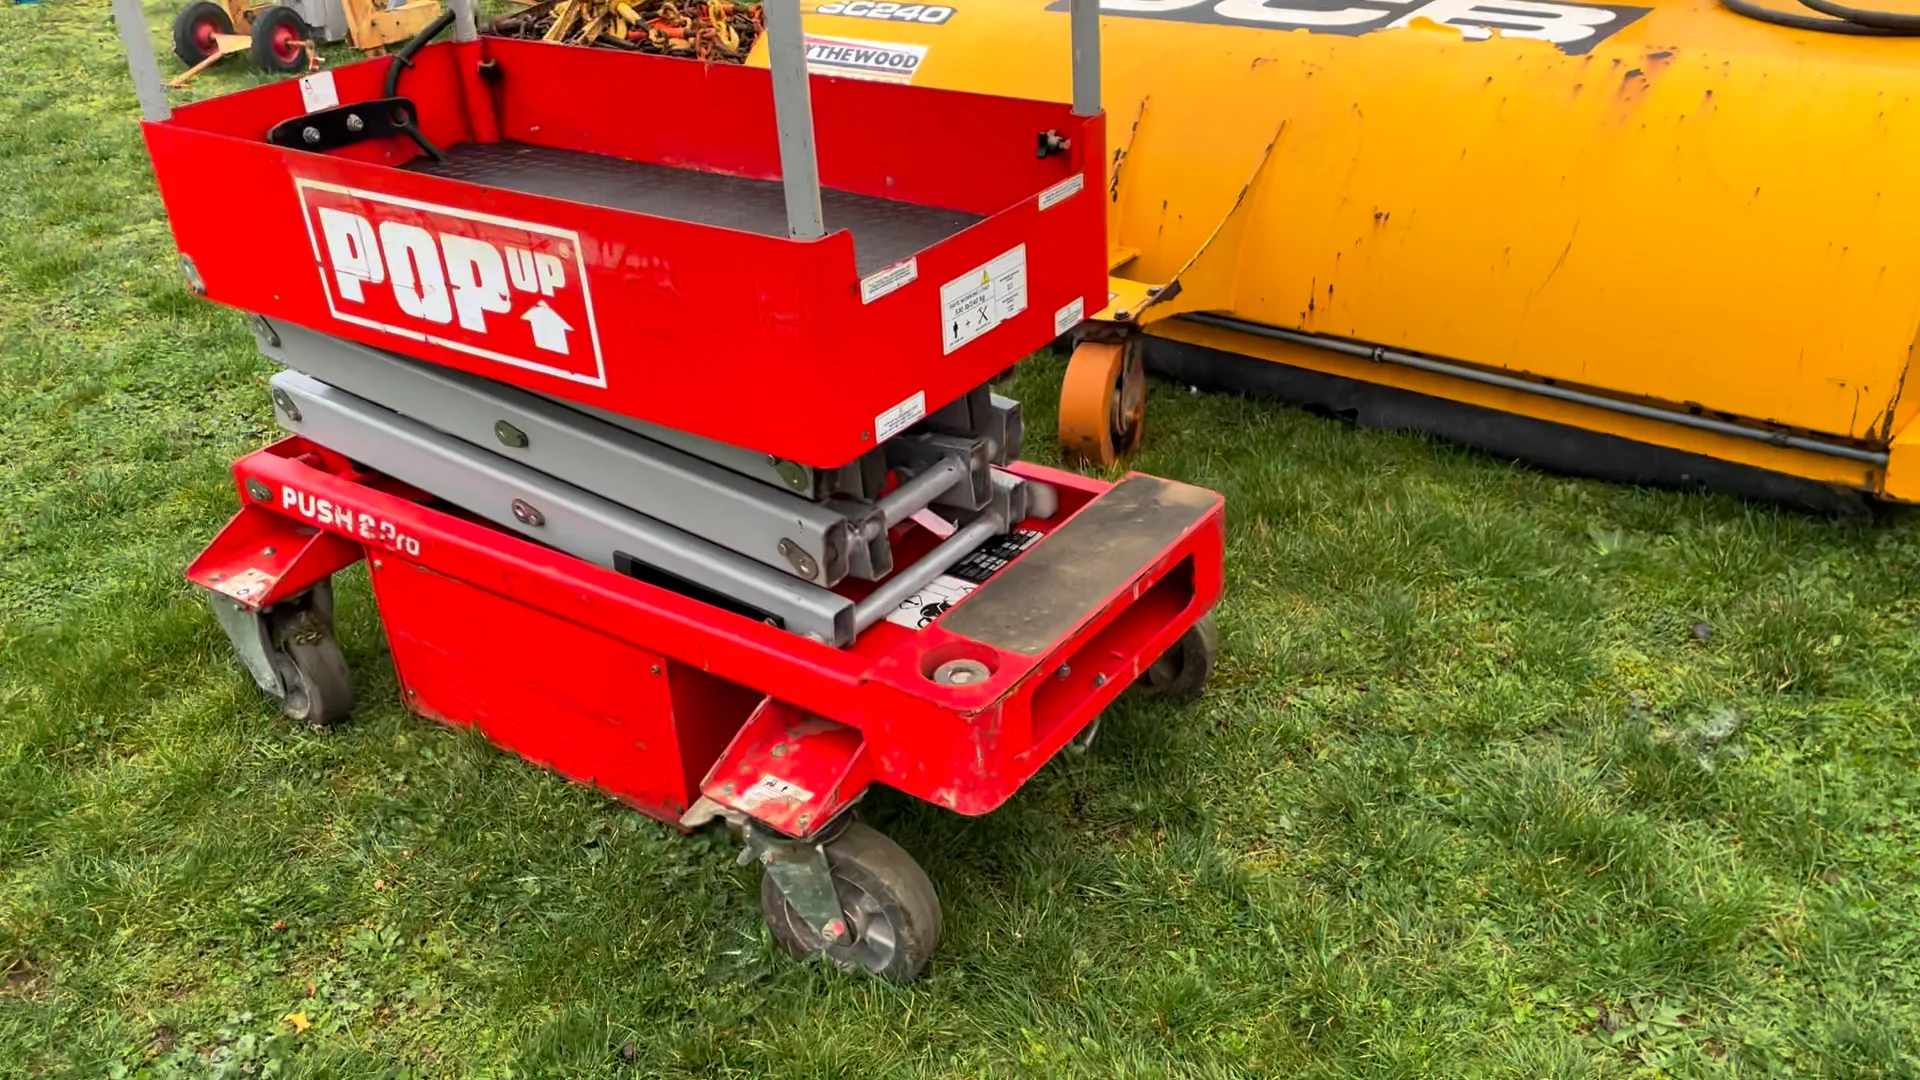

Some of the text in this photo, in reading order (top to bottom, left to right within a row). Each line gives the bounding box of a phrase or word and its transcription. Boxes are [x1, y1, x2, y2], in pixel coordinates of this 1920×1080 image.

[818, 0, 952, 23] SC240
[317, 206, 567, 334] POP UP
[282, 485, 353, 533] PUSH
